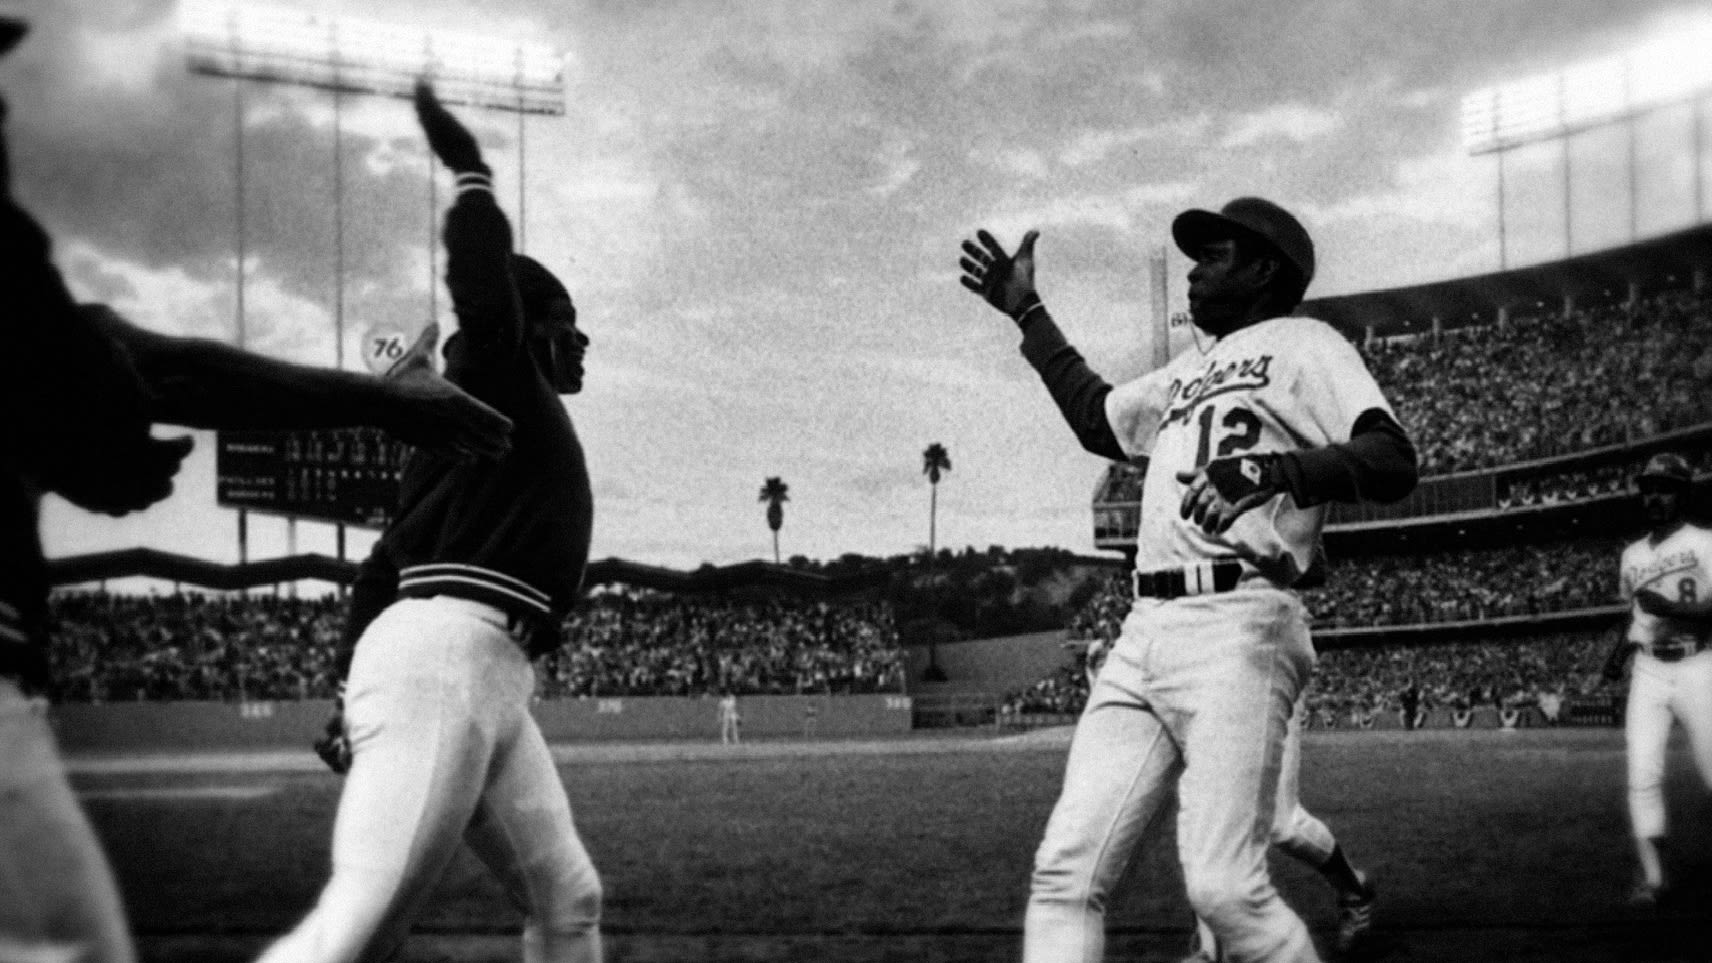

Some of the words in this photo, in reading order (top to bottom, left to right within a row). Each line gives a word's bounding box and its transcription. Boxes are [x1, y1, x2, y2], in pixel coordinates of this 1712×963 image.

[373, 337, 404, 359] 76
[1194, 404, 1262, 468] 12
[1677, 576, 1698, 604] 8
